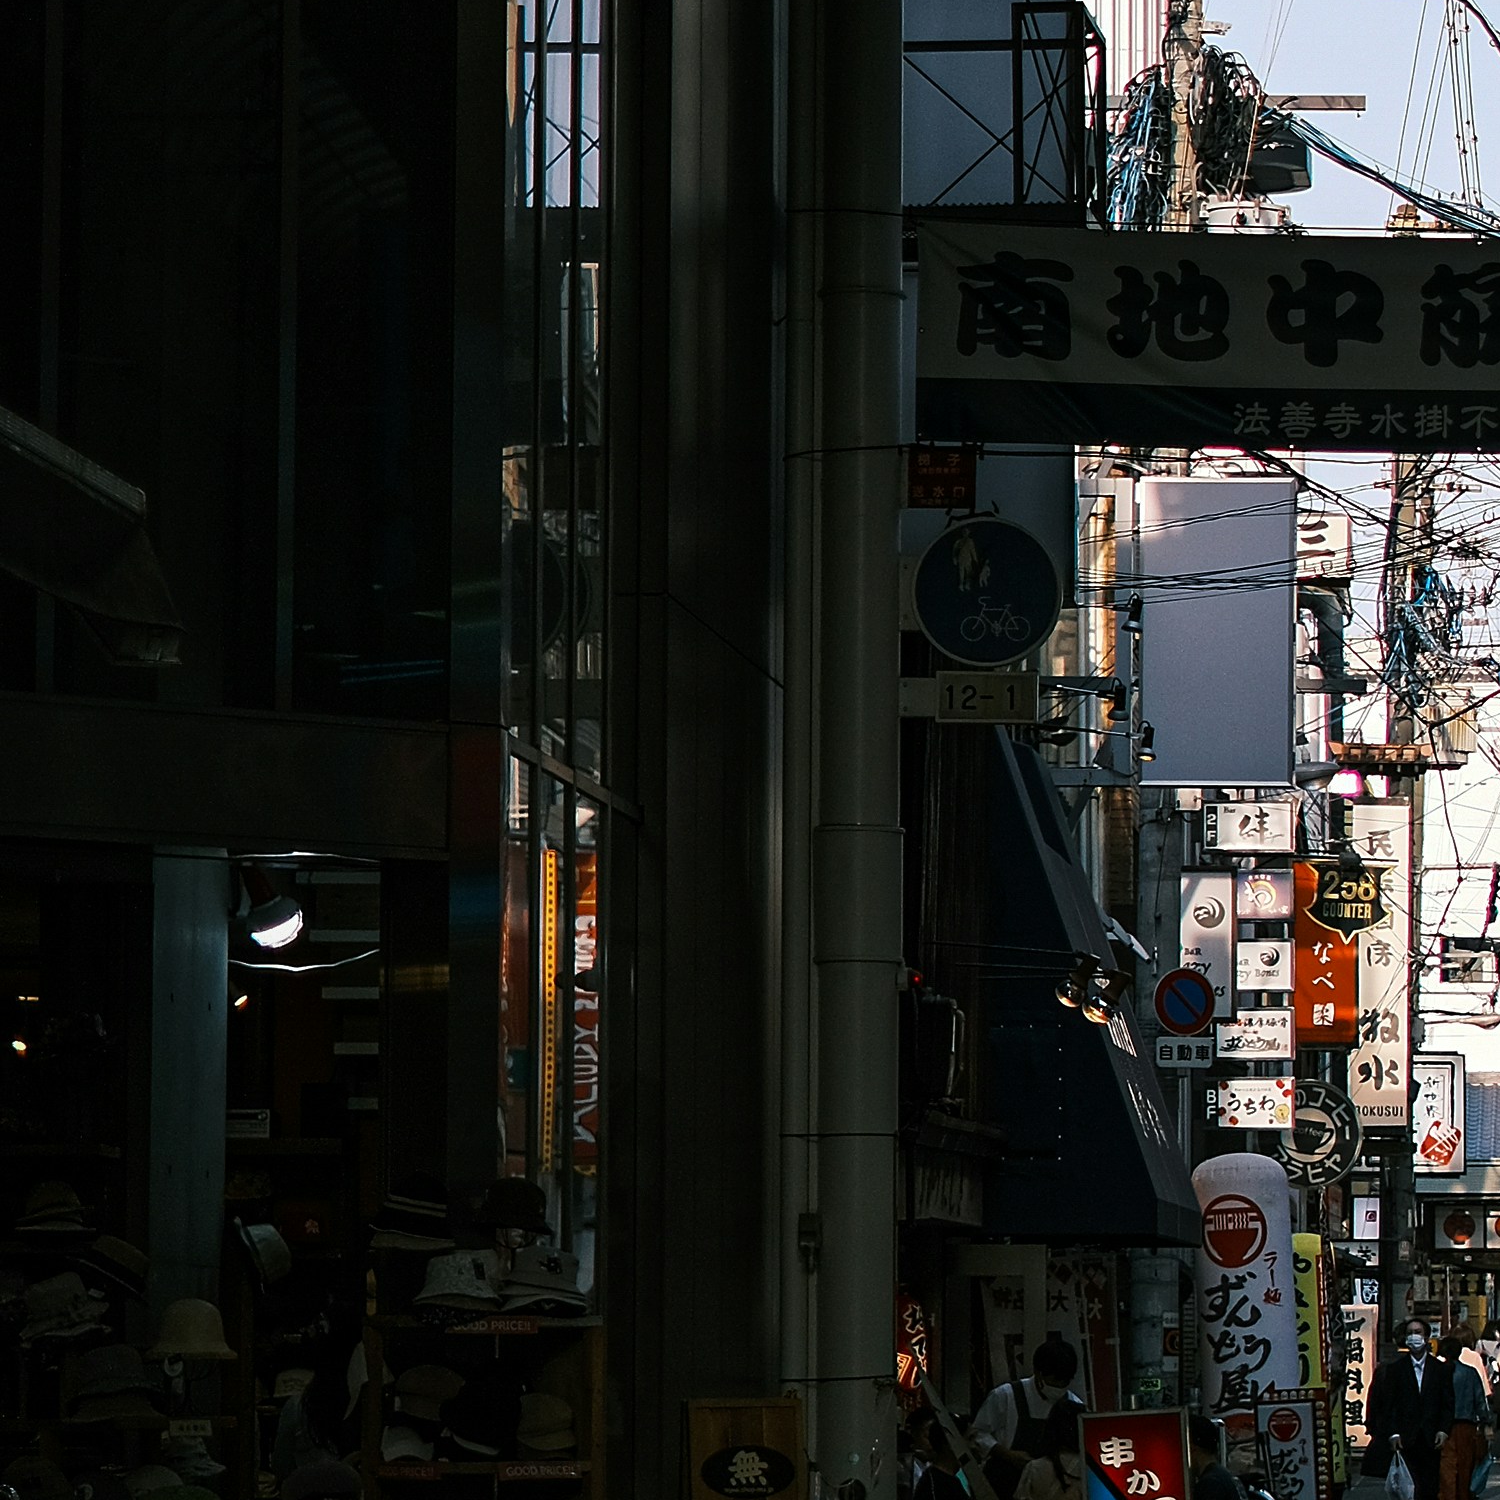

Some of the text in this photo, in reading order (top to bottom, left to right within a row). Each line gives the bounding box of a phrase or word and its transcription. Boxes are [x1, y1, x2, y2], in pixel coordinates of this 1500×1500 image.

[1206, 812, 1218, 842] 2F
[1323, 902, 1372, 920] COUNTER
[1160, 1044, 1210, 1061] 自動車
[1206, 1089, 1217, 1119] BF
[1227, 1094, 1276, 1116] うちわ
